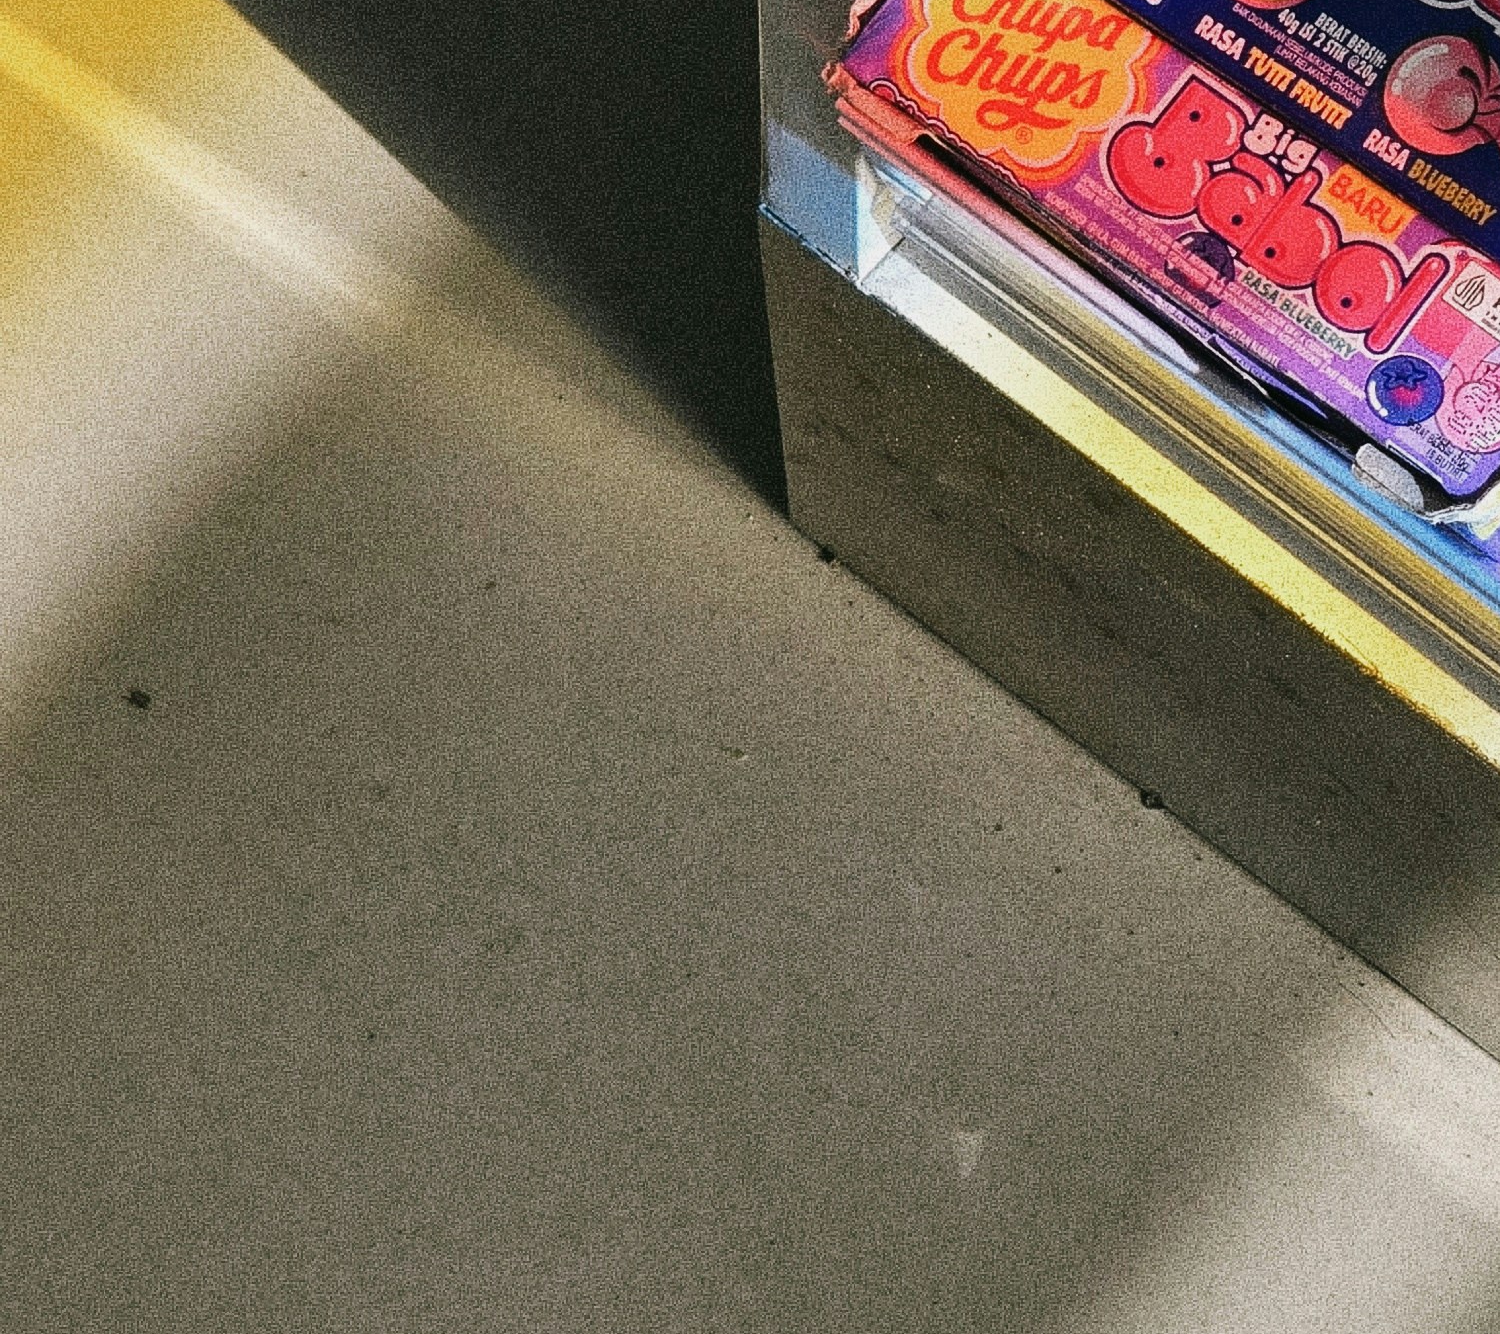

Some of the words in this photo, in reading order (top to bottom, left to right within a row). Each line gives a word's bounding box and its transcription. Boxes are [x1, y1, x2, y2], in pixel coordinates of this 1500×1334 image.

[926, 29, 1103, 130] Chups
[1192, 12, 1249, 62] RASA
[1240, 44, 1295, 93] TUTTI
[1288, 76, 1353, 132] FRUTTI
[1272, 6, 1304, 37] 40g
[1311, 31, 1328, 49] 2
[1320, 38, 1349, 65] STIK
[1312, 9, 1353, 45] BERAT
[1344, 31, 1391, 72] BERSIH:
[1238, 108, 1320, 183] Big
[1361, 126, 1413, 173] RASA
[1405, 154, 1498, 230] BLUEBERRY
[1107, 76, 1447, 354] Babol
[1325, 170, 1408, 239] BARU
[1239, 268, 1284, 307] RASA
[1276, 296, 1358, 361] BLUEBERRY
